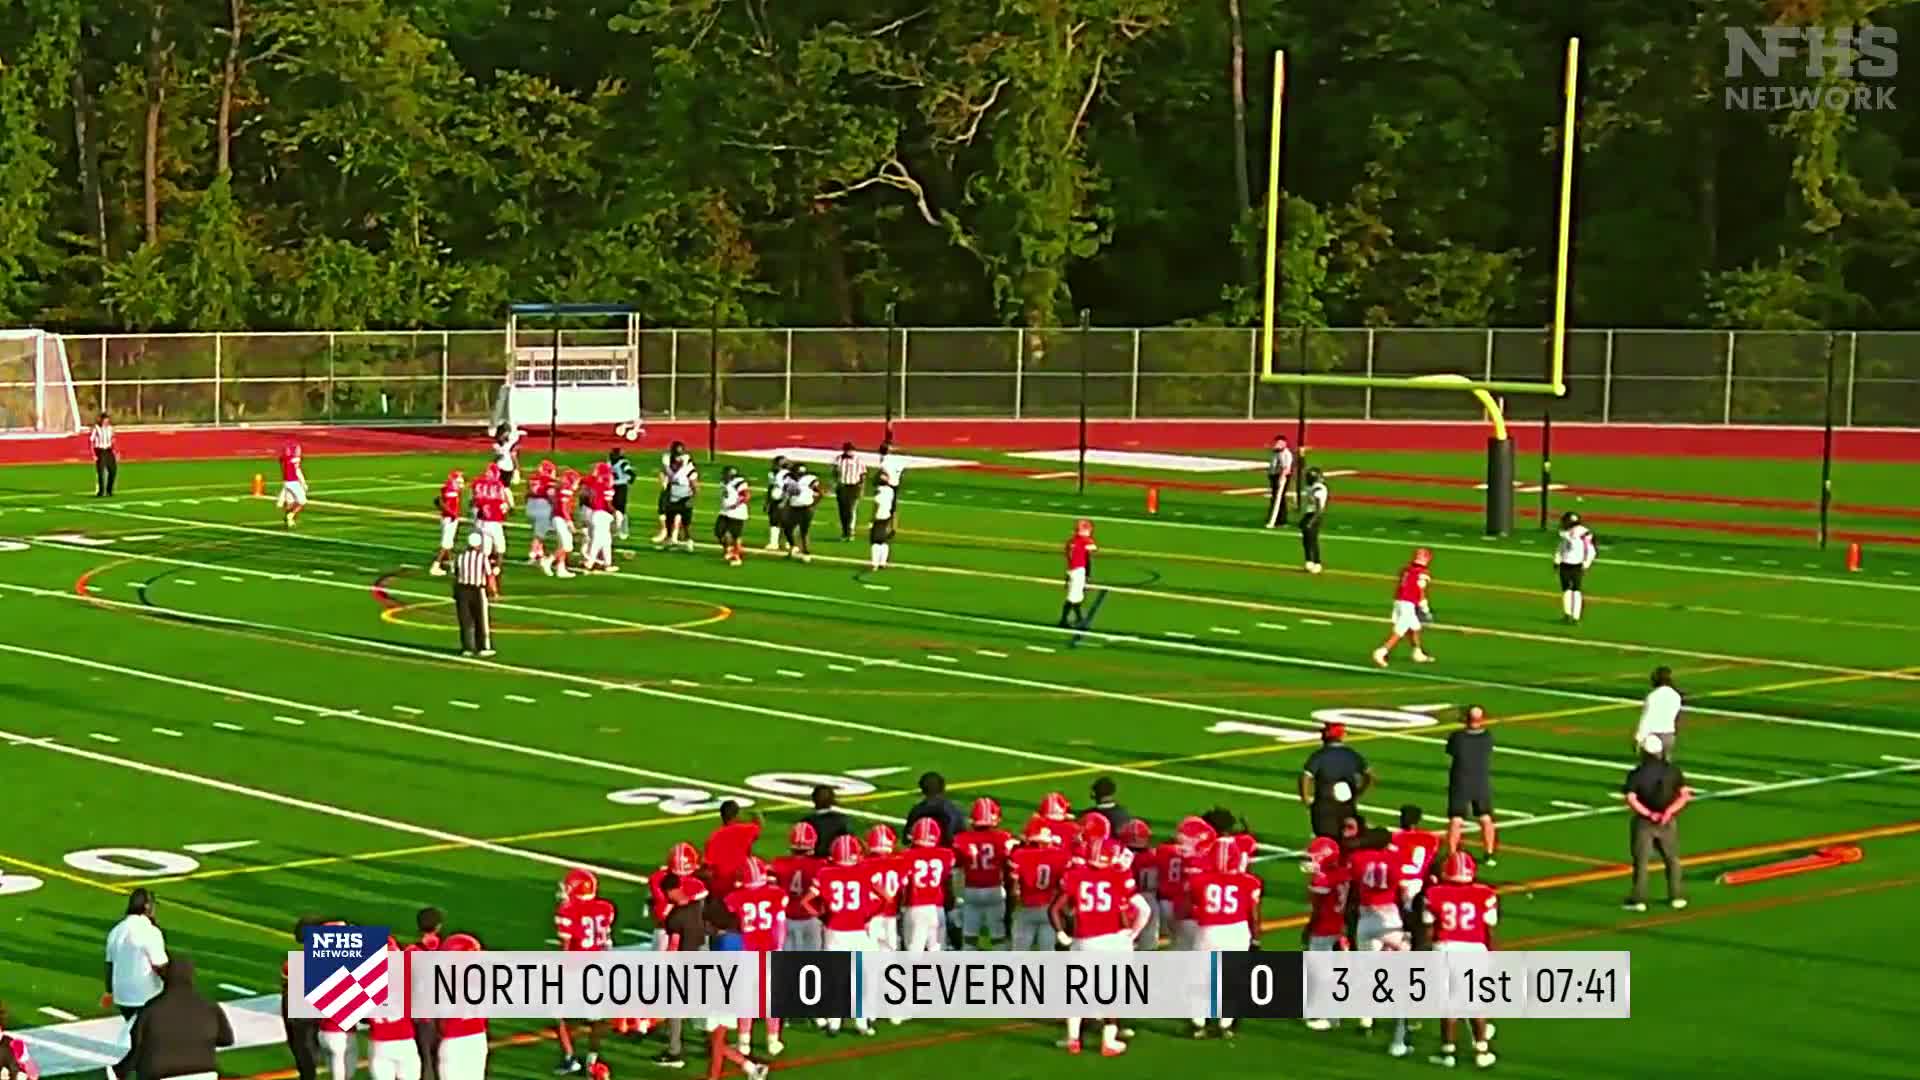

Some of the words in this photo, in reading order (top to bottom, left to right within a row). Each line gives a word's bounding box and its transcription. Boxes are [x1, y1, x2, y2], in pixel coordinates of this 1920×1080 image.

[606, 772, 878, 816] 20
[968, 843, 994, 870] 12
[914, 859, 943, 888] 23
[1362, 861, 1388, 889] 41
[830, 880, 861, 912] 33
[1079, 880, 1112, 912] 55
[1205, 884, 1238, 914] 95
[581, 915, 608, 948] 35
[742, 900, 773, 932] 25
[1441, 902, 1476, 931] 32
